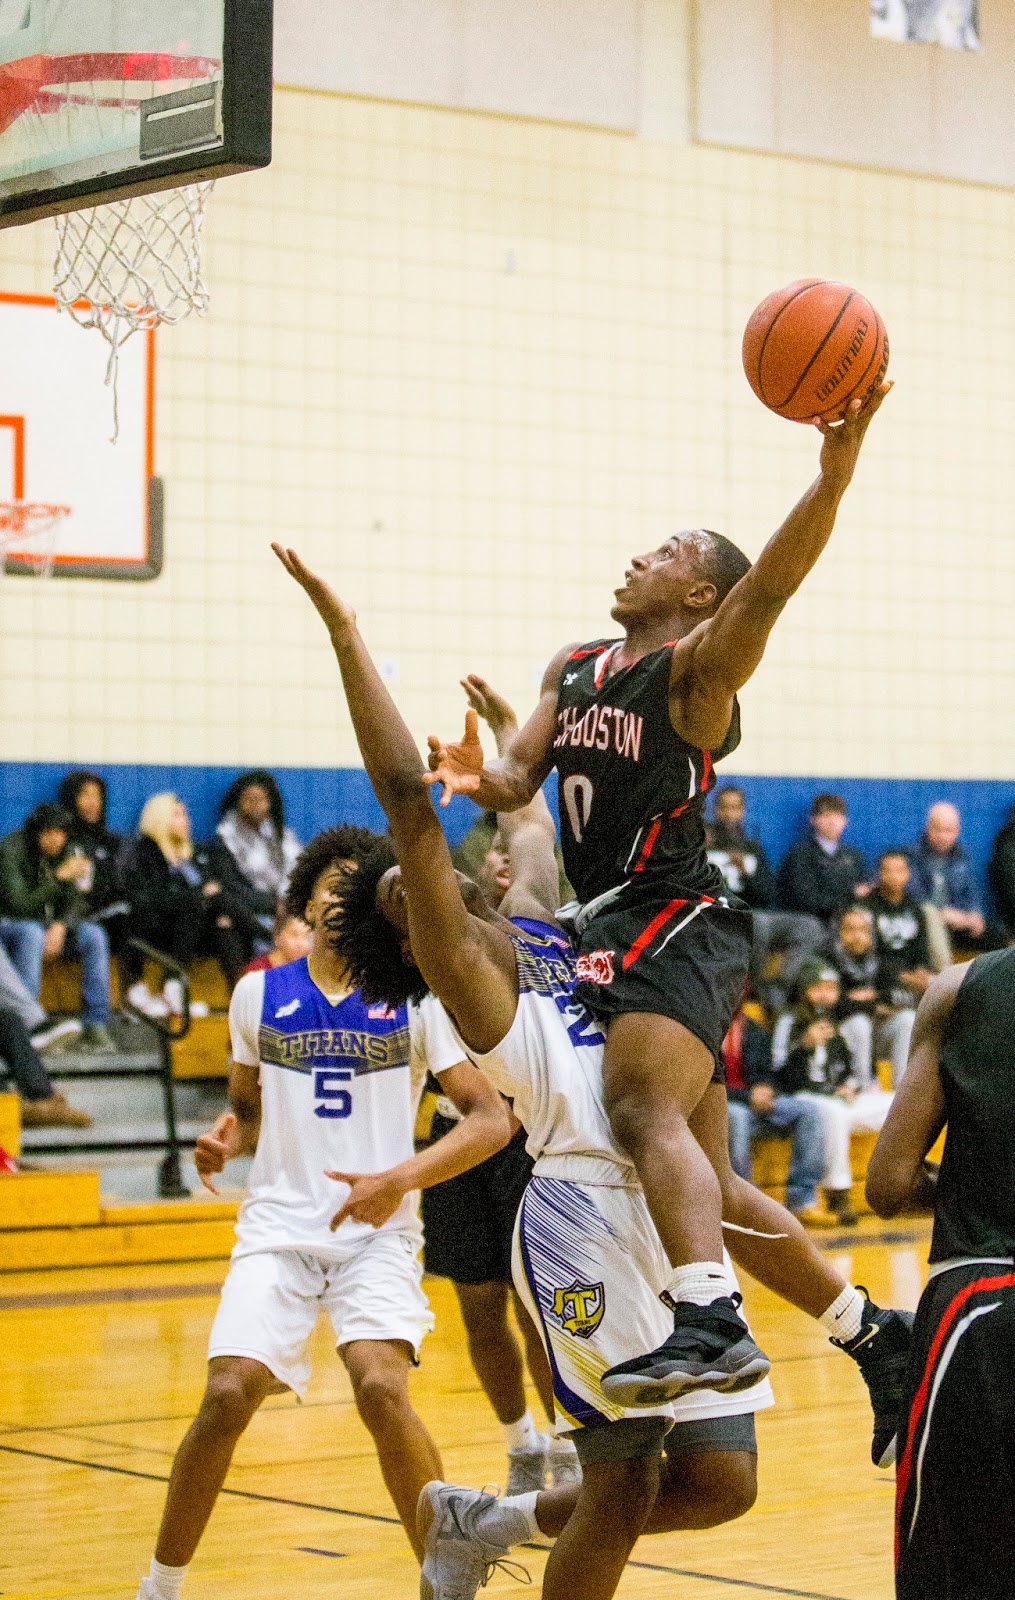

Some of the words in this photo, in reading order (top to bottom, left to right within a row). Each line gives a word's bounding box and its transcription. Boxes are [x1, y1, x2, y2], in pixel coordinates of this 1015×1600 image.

[563, 775, 593, 844] 0
[278, 1029, 389, 1065] TITANS
[313, 1070, 353, 1119] 5
